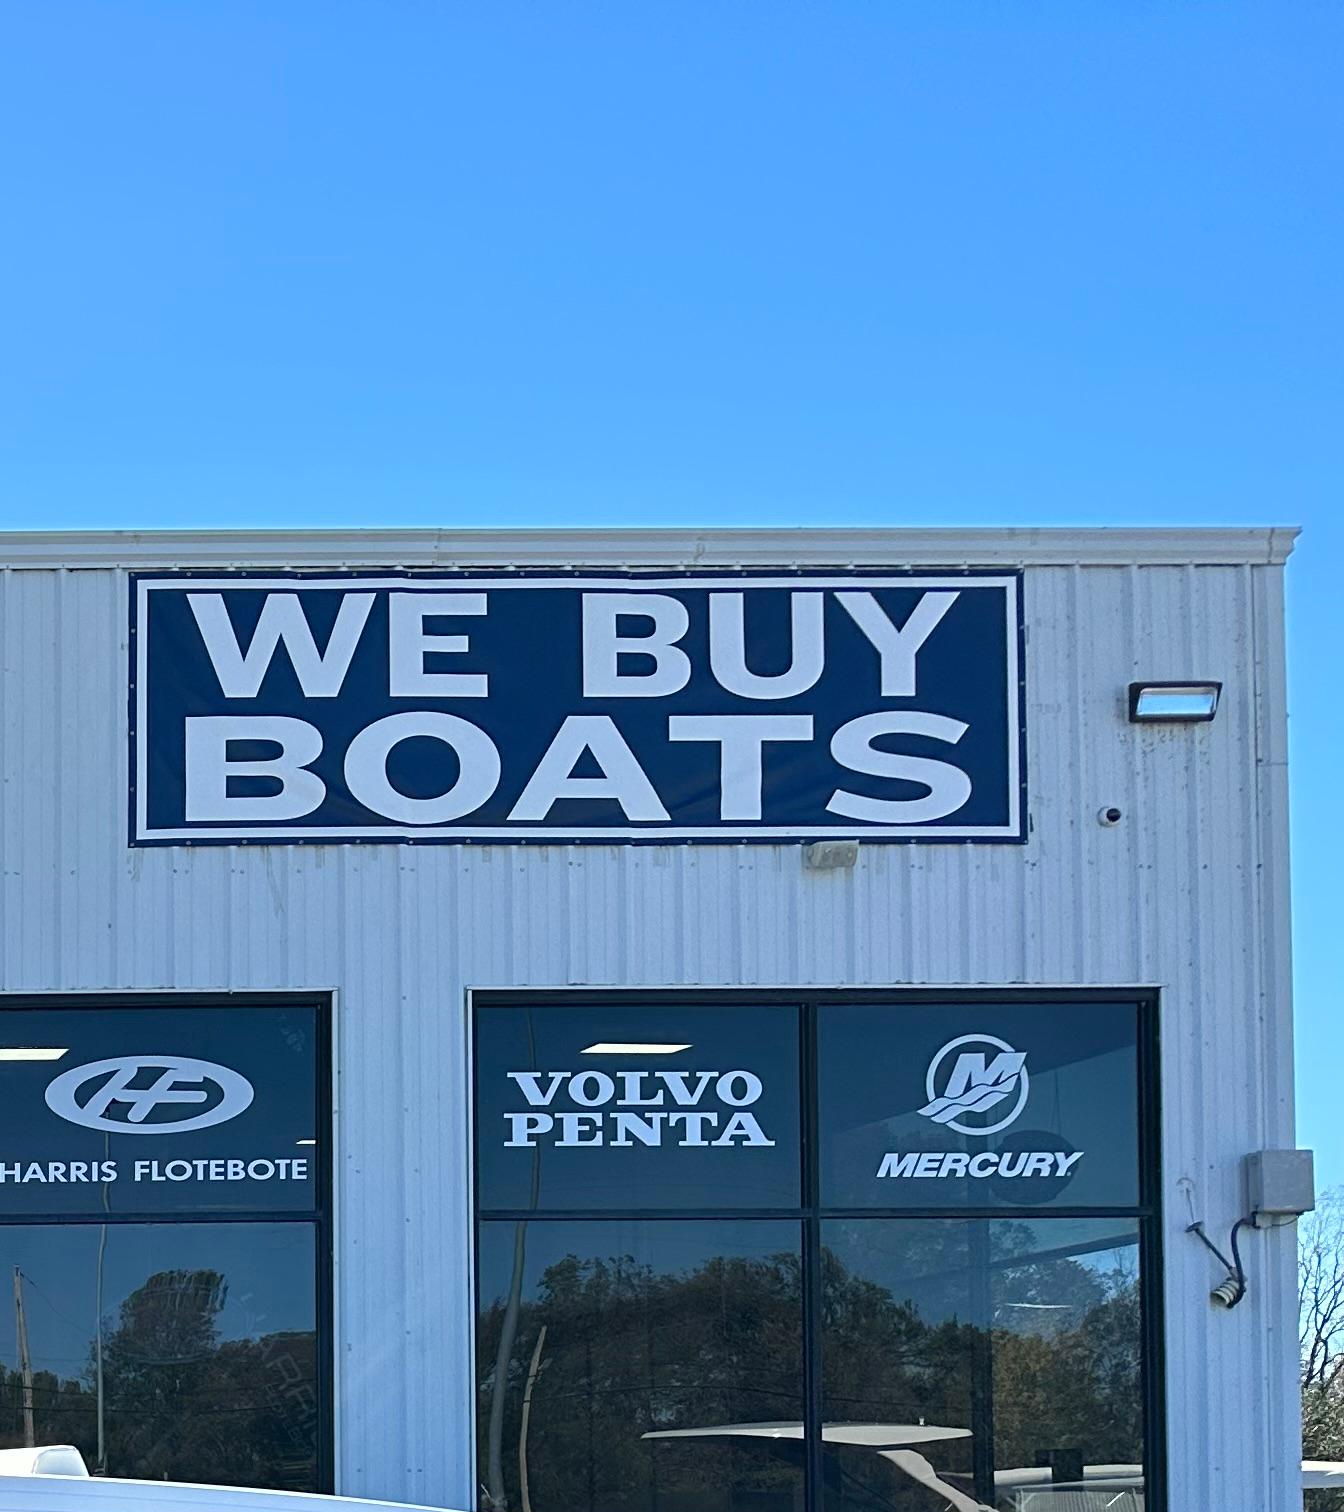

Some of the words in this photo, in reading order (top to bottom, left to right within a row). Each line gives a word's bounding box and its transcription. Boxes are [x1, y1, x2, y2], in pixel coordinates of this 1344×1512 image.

[185, 592, 489, 698] WE
[582, 591, 961, 700] BUY
[185, 710, 972, 825] BOATS
[506, 1070, 764, 1107] VOLVO
[503, 1112, 776, 1147] PENTA
[133, 1158, 308, 1182] FLOTEBOTE
[876, 1151, 1085, 1178] MERCURY
